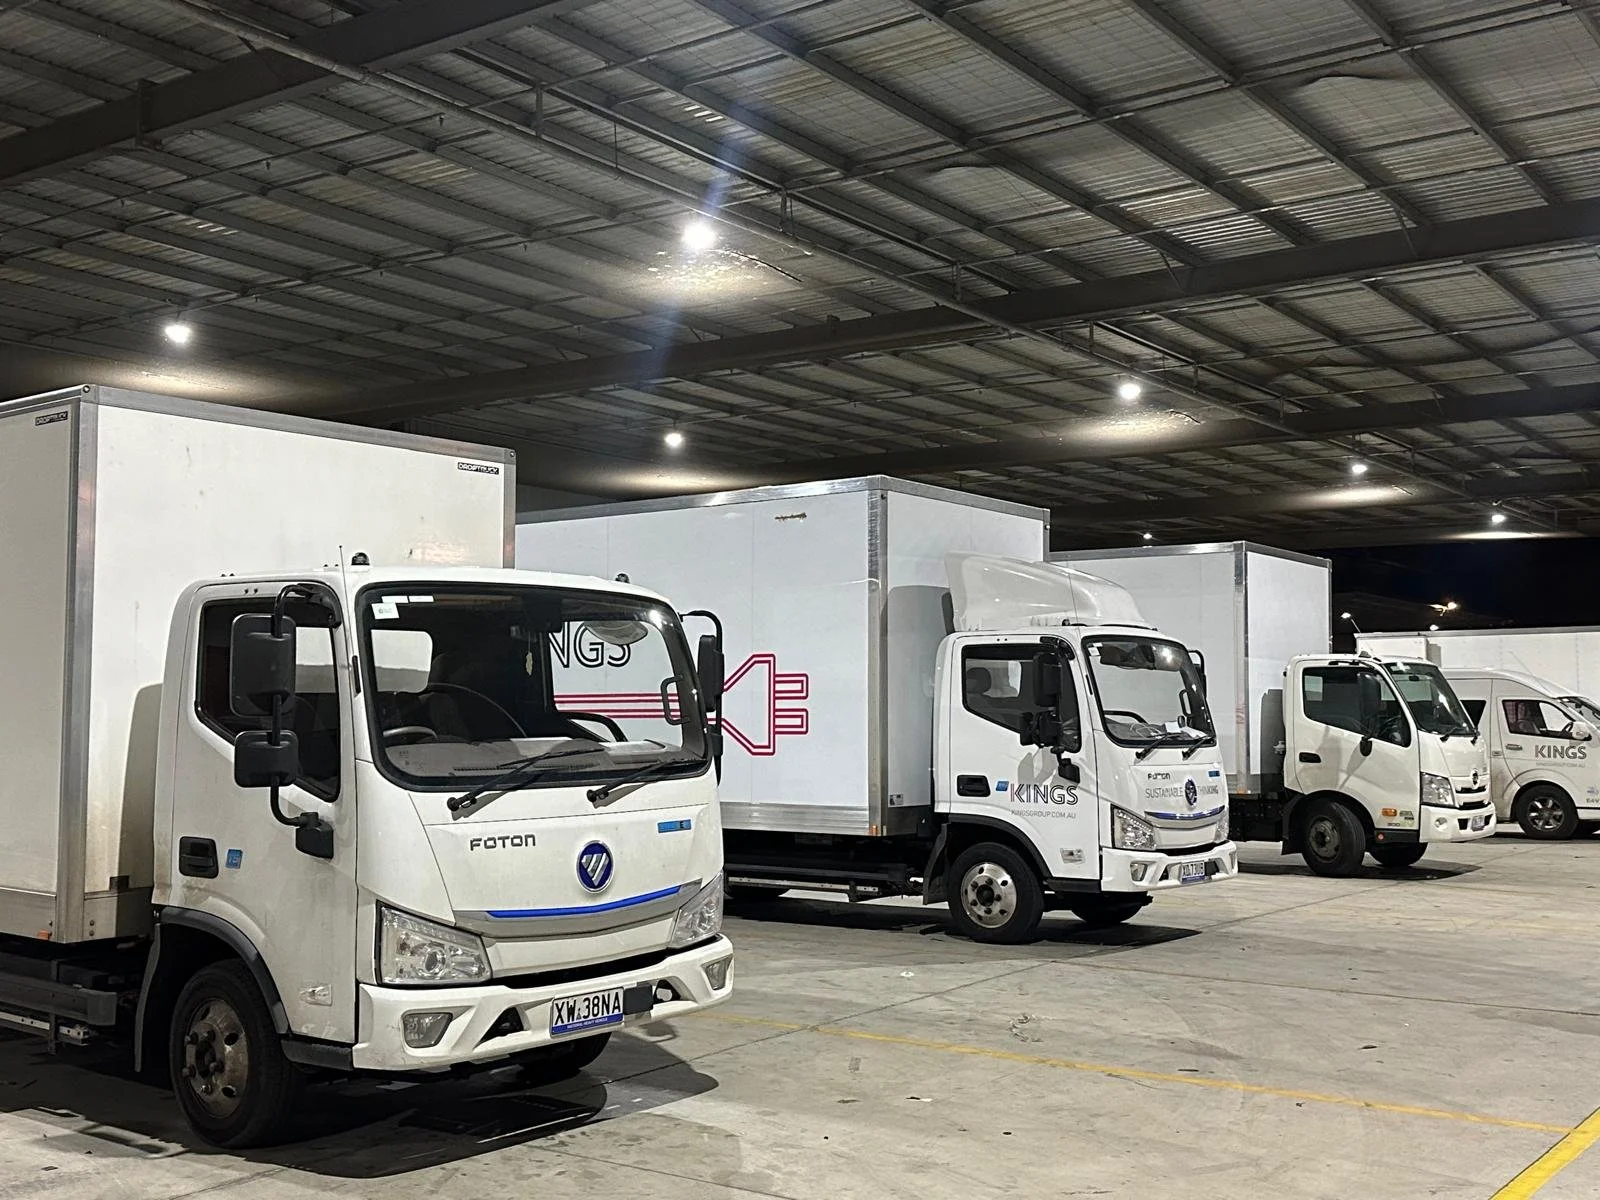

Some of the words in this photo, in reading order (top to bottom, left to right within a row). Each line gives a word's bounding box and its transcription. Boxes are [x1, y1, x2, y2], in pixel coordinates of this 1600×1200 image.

[1535, 744, 1587, 760] KINGS
[1010, 783, 1078, 805] KINGS
[470, 834, 536, 851] FOTON
